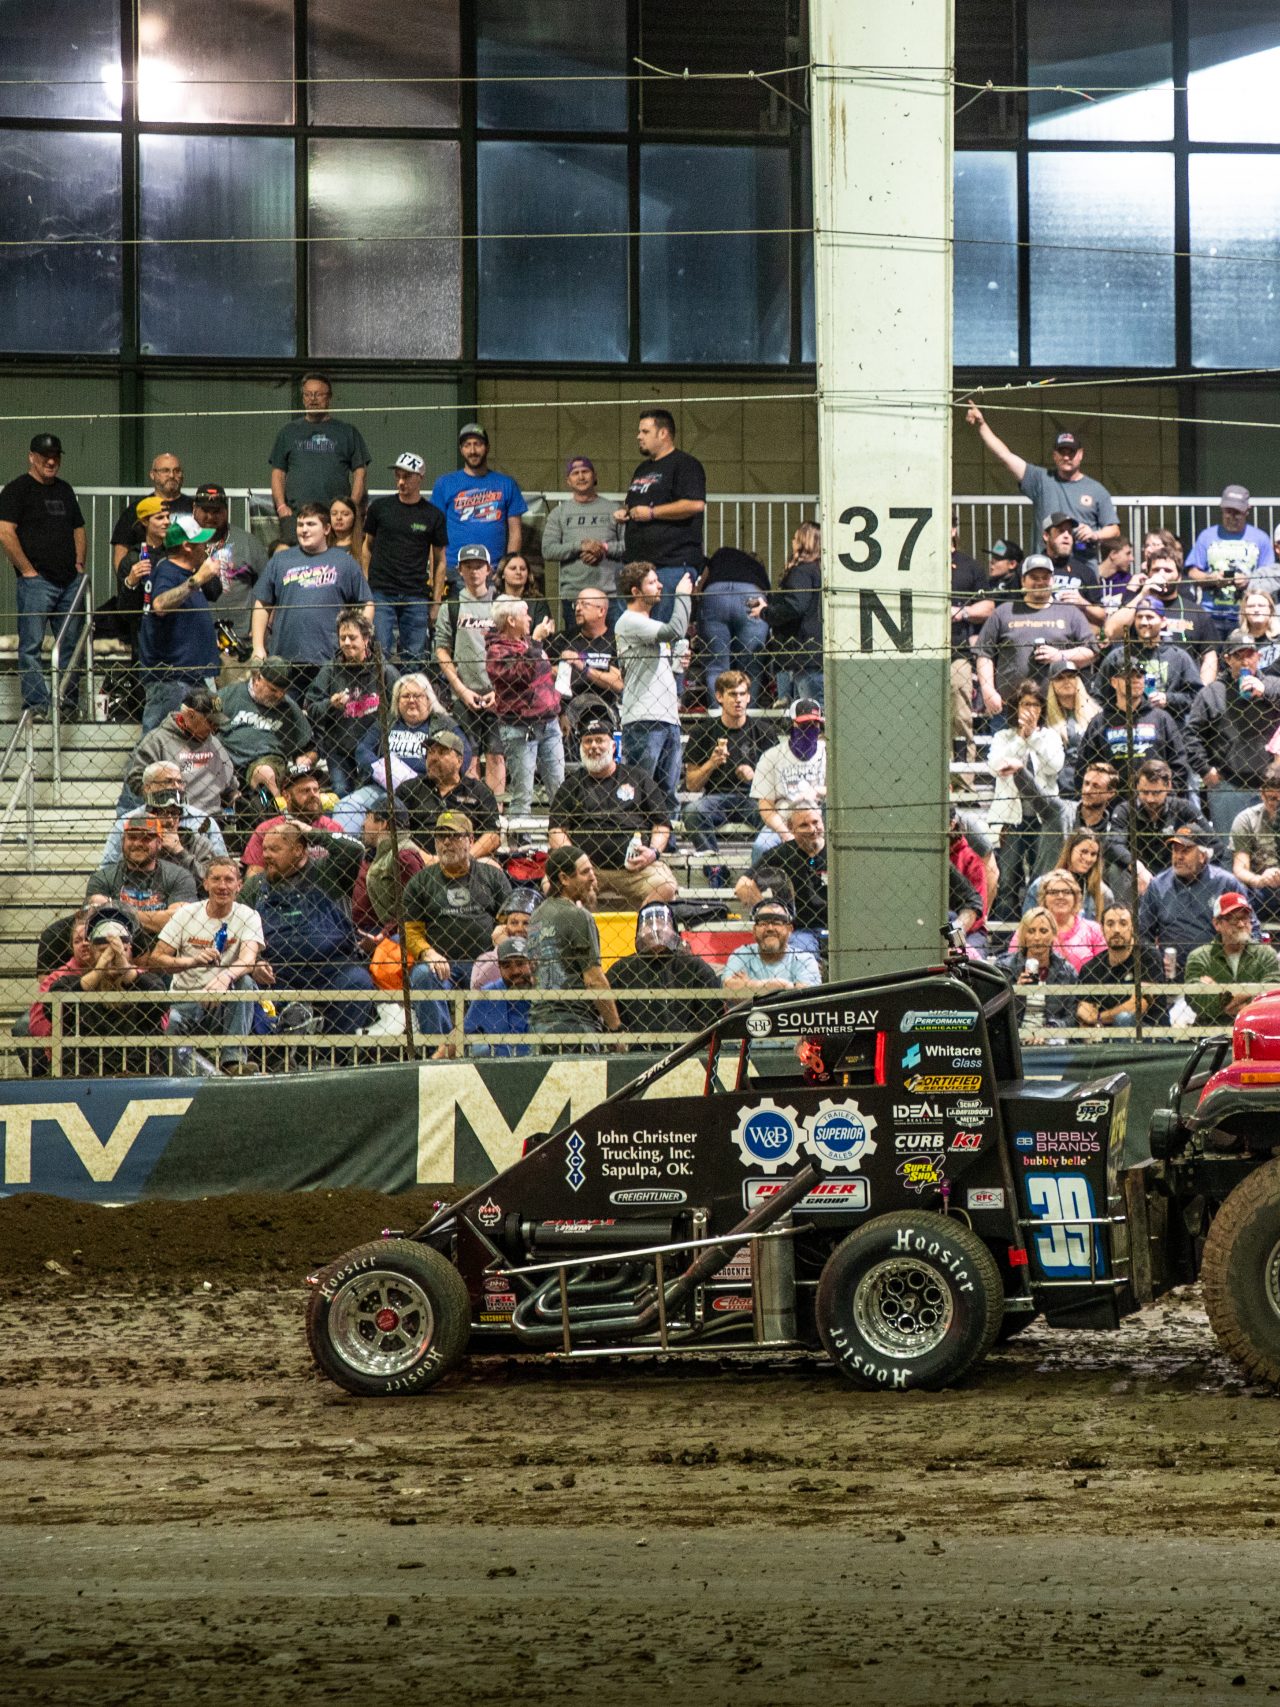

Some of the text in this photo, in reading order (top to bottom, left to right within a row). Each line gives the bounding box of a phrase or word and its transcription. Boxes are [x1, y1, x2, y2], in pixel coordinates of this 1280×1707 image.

[838, 506, 933, 572] 37
[859, 588, 914, 654] N
[746, 1019, 771, 1032] SBP
[777, 1010, 879, 1027] SOUTH BAY
[800, 1026, 853, 1034] PARTNERS
[925, 1045, 982, 1057] Whitacre
[952, 1058, 983, 1068] Glass
[823, 1111, 855, 1122] TRAILER
[893, 1101, 943, 1118] IDEAL
[597, 1130, 698, 1146] John Christner
[749, 1126, 788, 1148] W&B
[815, 1127, 864, 1141] SUPERIOR
[1036, 1131, 1098, 1142] BUBBLY
[895, 1135, 945, 1149] CURB
[1036, 1142, 1101, 1152] BRANDS
[601, 1147, 696, 1163] Trucking, Inc.
[828, 1150, 854, 1160] SALES
[1023, 1156, 1087, 1168] bubbly belle
[601, 1162, 694, 1180] Sapulpa, OK.
[904, 1164, 933, 1174] SUPER
[617, 1192, 680, 1201] FREIGHTLINER
[756, 1185, 857, 1195] PIER
[806, 1197, 849, 1205] GROUP
[1028, 1177, 1099, 1267] 39
[891, 1228, 975, 1293] Hoosier
[720, 1267, 752, 1277] HOENFE
[319, 1256, 377, 1303] Hoosier
[829, 1326, 914, 1389] Hoosier
[385, 1345, 444, 1393] Hoosier
